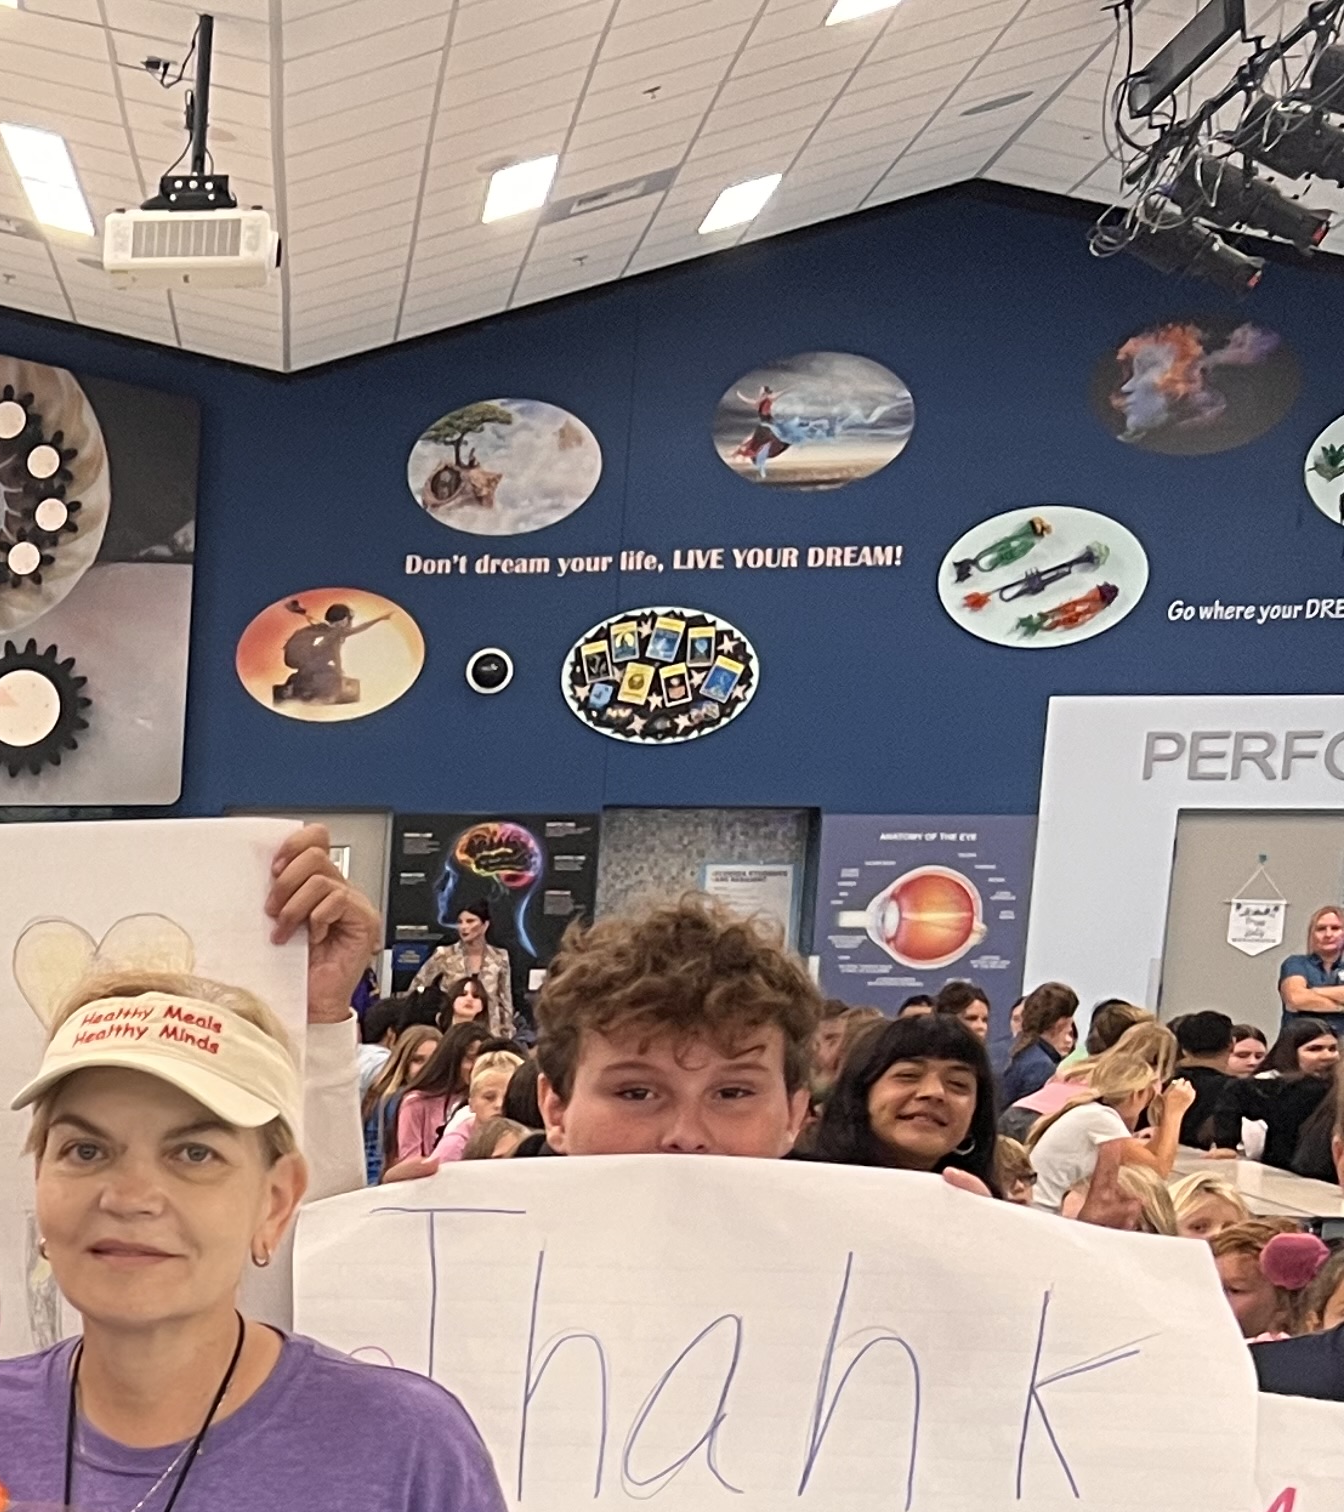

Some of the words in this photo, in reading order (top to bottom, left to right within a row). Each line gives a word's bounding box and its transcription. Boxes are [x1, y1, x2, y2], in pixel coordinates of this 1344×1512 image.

[405, 554, 469, 575] Don't
[474, 554, 551, 575] dream
[556, 555, 614, 578] your
[619, 551, 665, 574] life,
[673, 548, 725, 570] LIVE
[733, 547, 800, 569] YOUR
[806, 545, 904, 567] DREAM!
[1167, 600, 1195, 621] Go
[1199, 599, 1255, 620] where
[1257, 600, 1303, 624] your
[80, 1005, 154, 1027] Healthy
[163, 1004, 223, 1034] Meals
[71, 1023, 149, 1048] Healthy
[158, 1024, 220, 1054] Minds
[369, 1207, 1163, 1512] Thank
